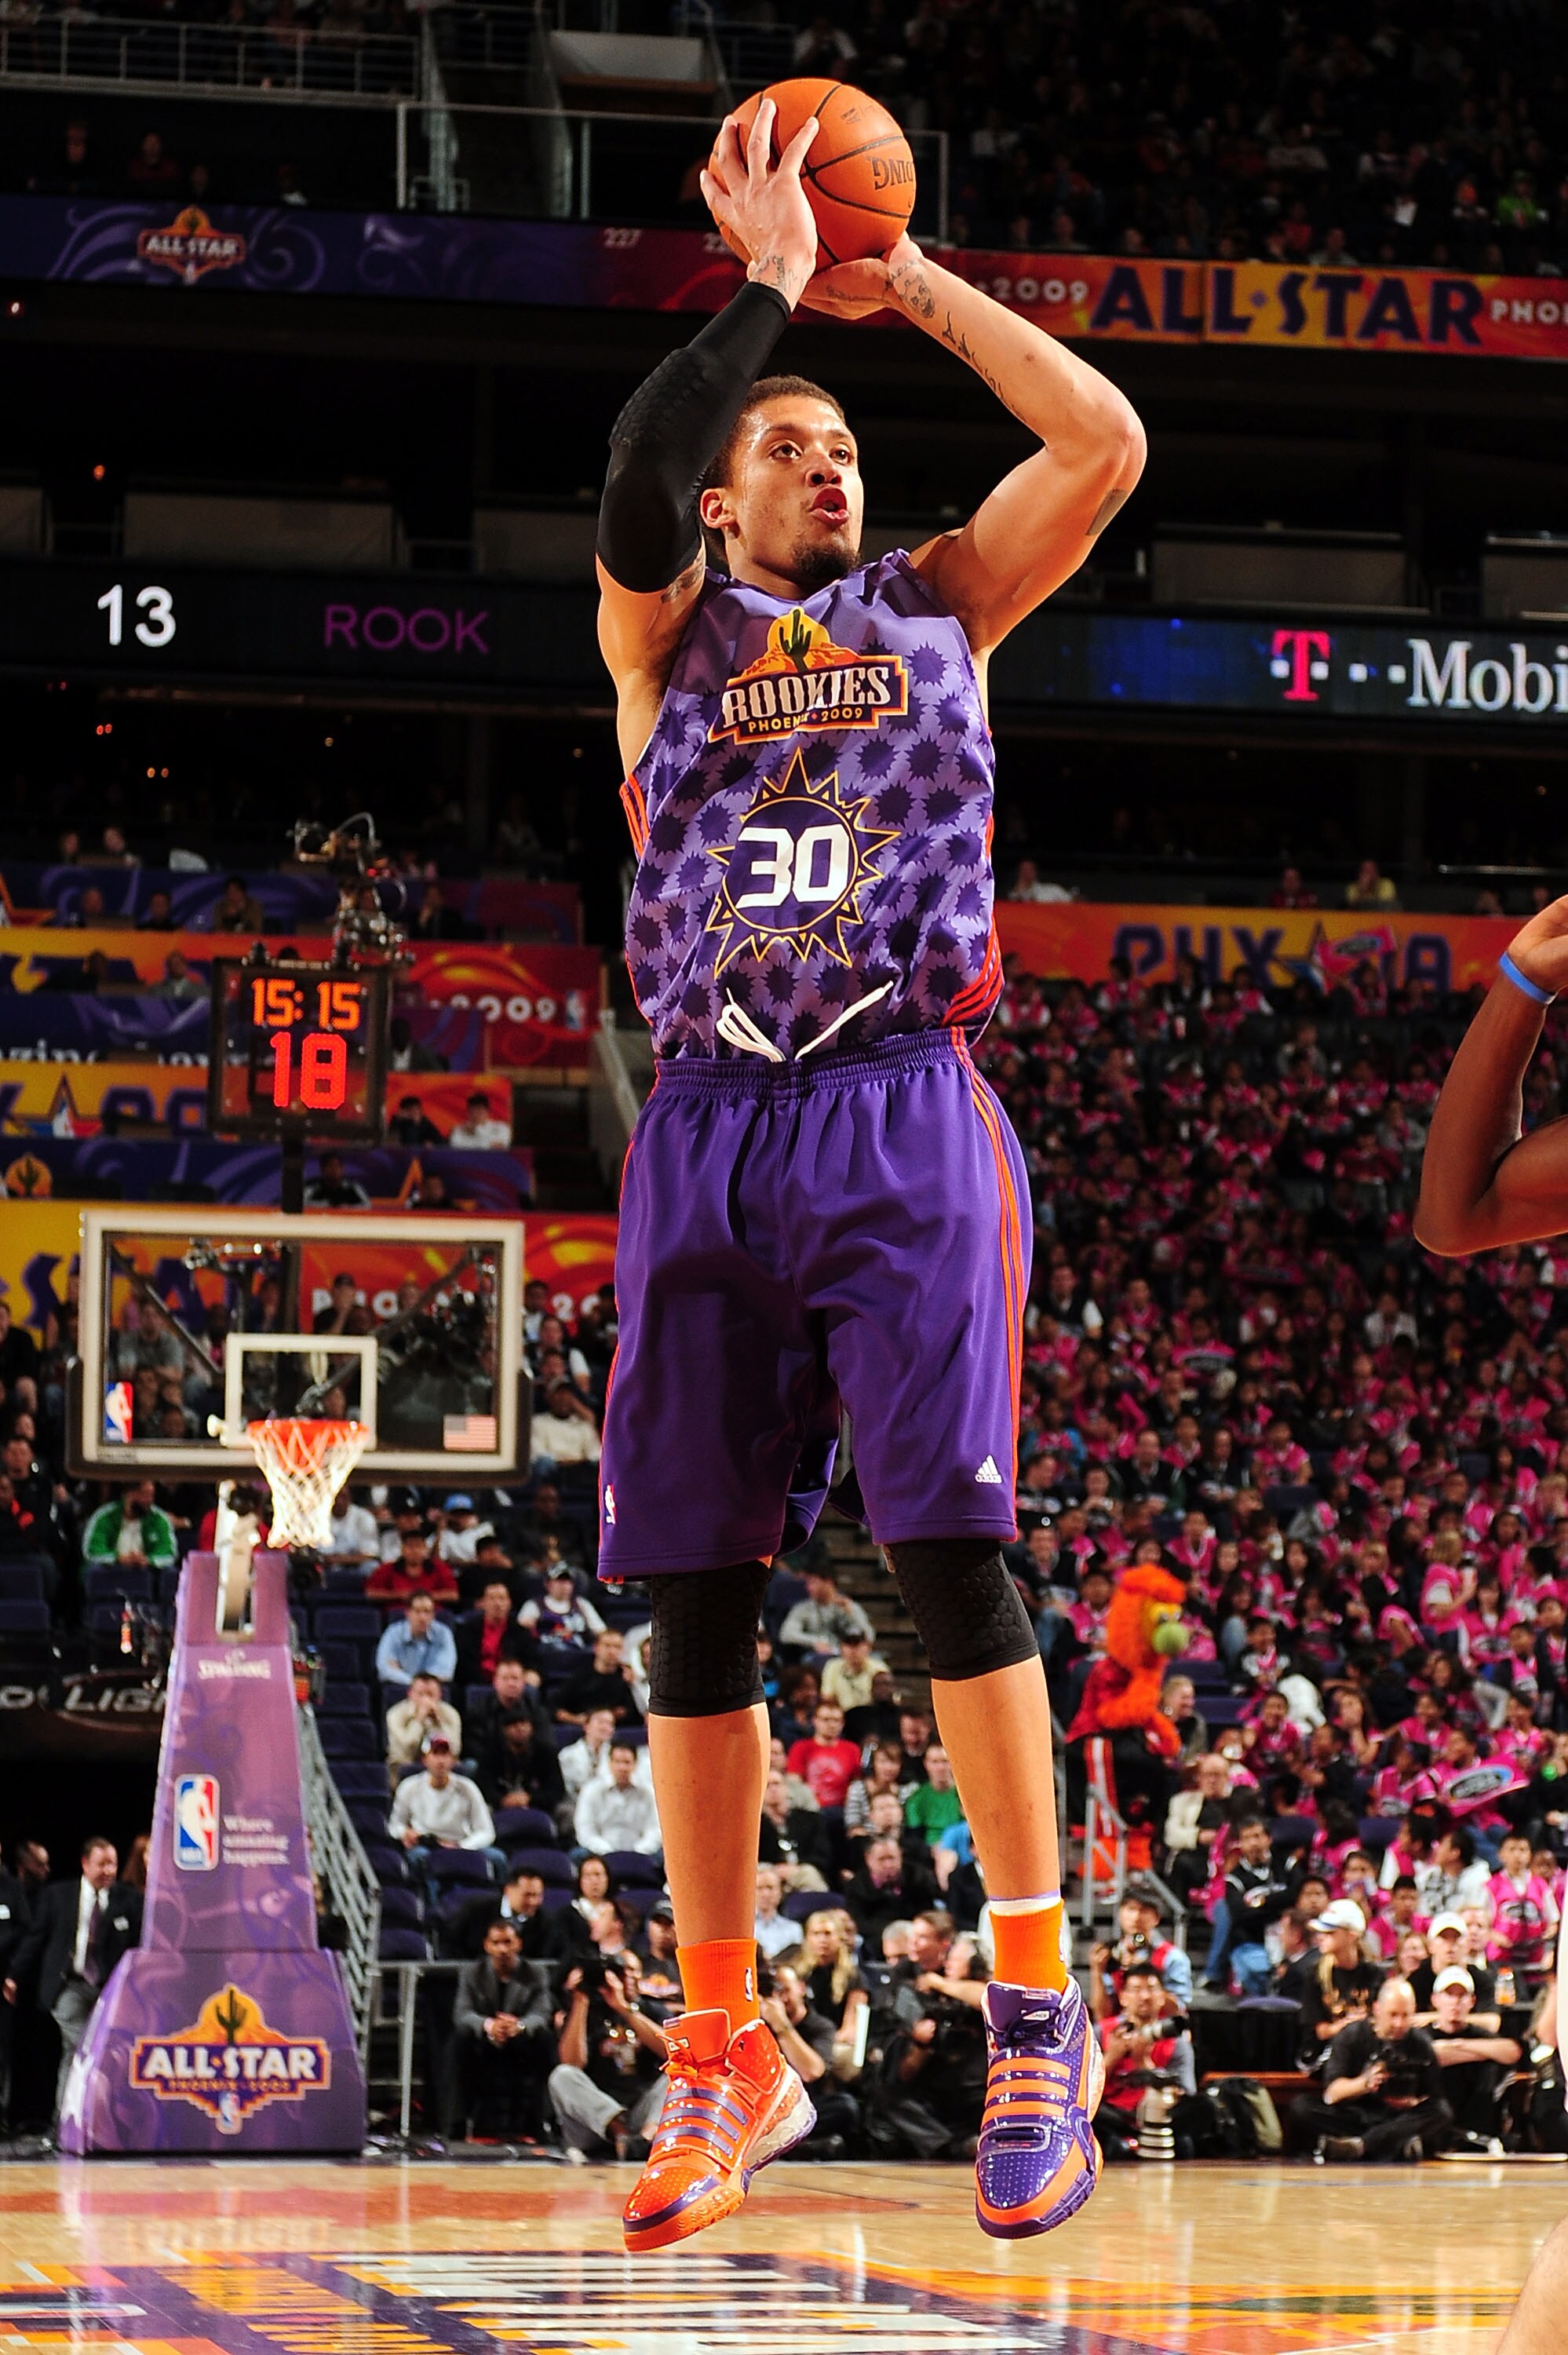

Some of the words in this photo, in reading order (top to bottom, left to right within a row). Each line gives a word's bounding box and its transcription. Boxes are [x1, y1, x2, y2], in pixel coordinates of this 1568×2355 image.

[992, 276, 1088, 303] 2009
[97, 583, 177, 648] 13
[324, 604, 490, 654] ROOK
[721, 666, 892, 728] ROOKIES
[821, 706, 863, 723] 2009
[735, 824, 851, 909] 30
[269, 1031, 348, 1111] 18
